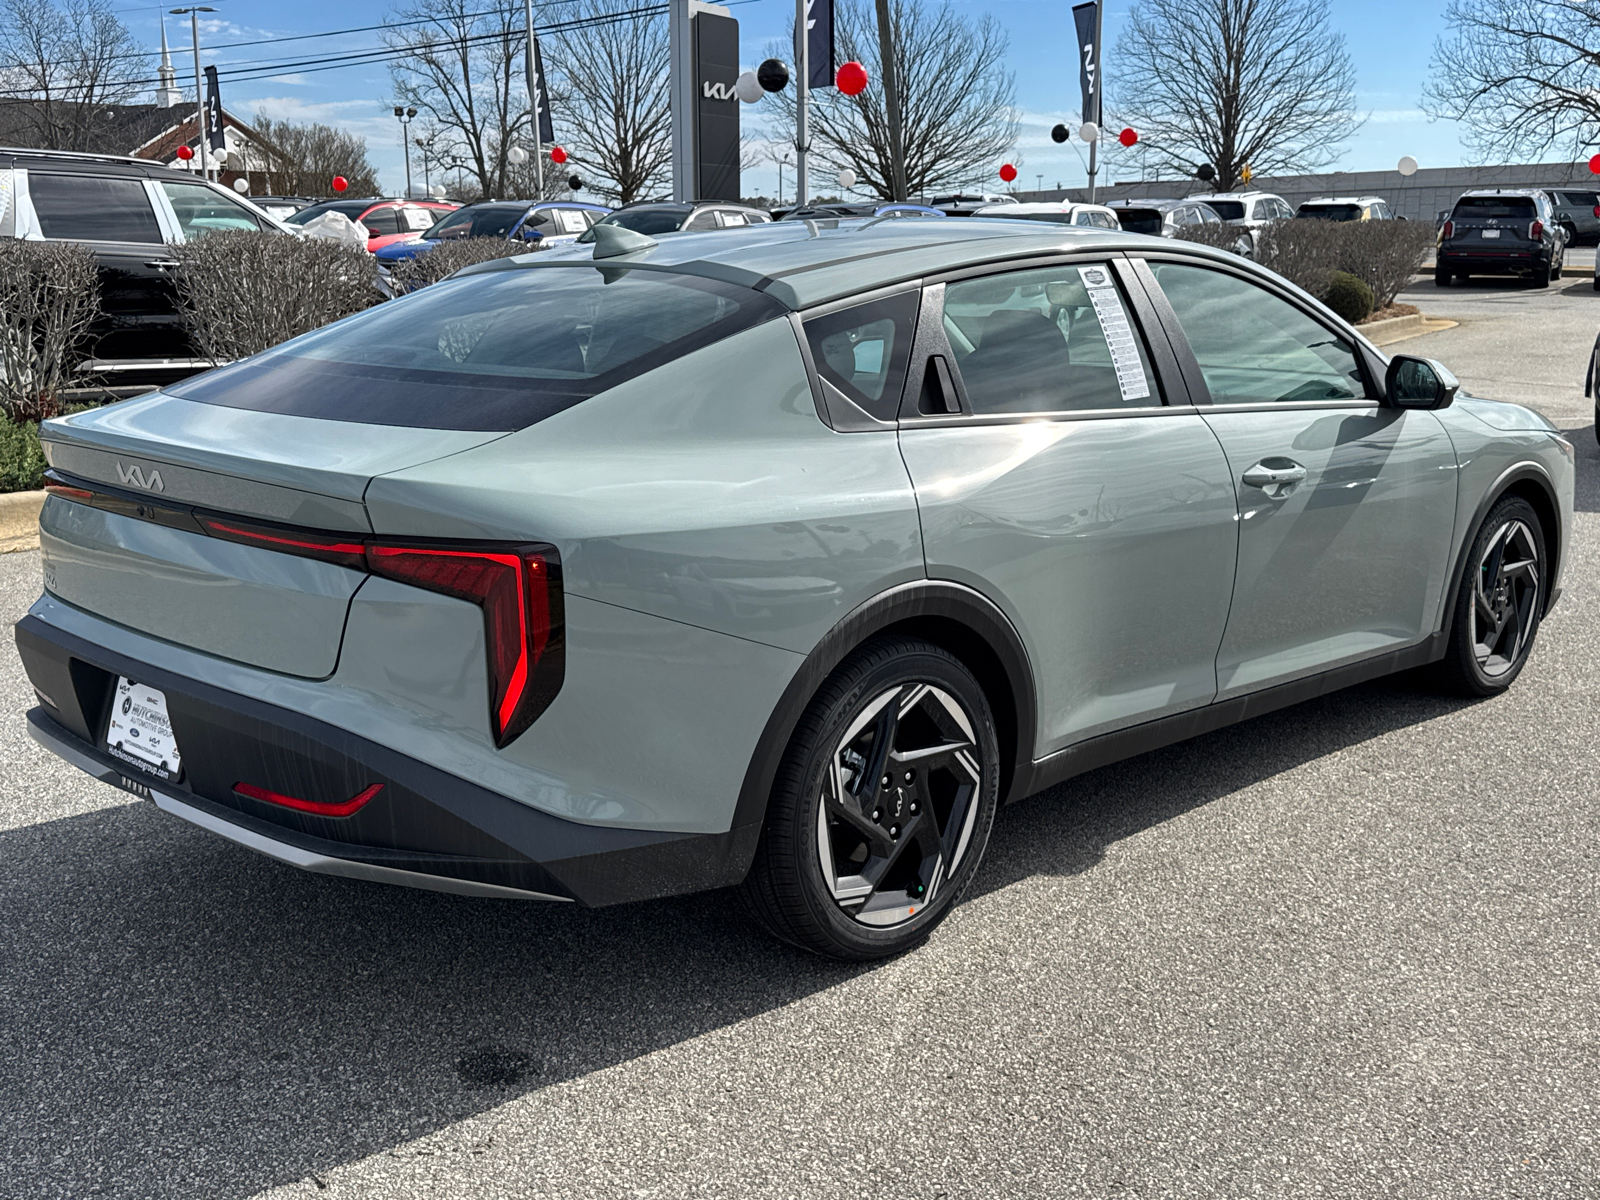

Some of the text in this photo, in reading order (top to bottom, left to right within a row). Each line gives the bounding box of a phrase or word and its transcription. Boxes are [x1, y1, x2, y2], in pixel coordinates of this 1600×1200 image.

[703, 80, 739, 101] KIA
[116, 460, 165, 492] KIA
[130, 716, 158, 733] AUTOMOTIVE
[157, 727, 174, 739] GROUP
[131, 703, 172, 729] HUTCHINSO
[149, 736, 160, 745] KIA
[108, 745, 169, 780] Hutchinsonautogroup.com
[984, 763, 999, 834] KUMHO
